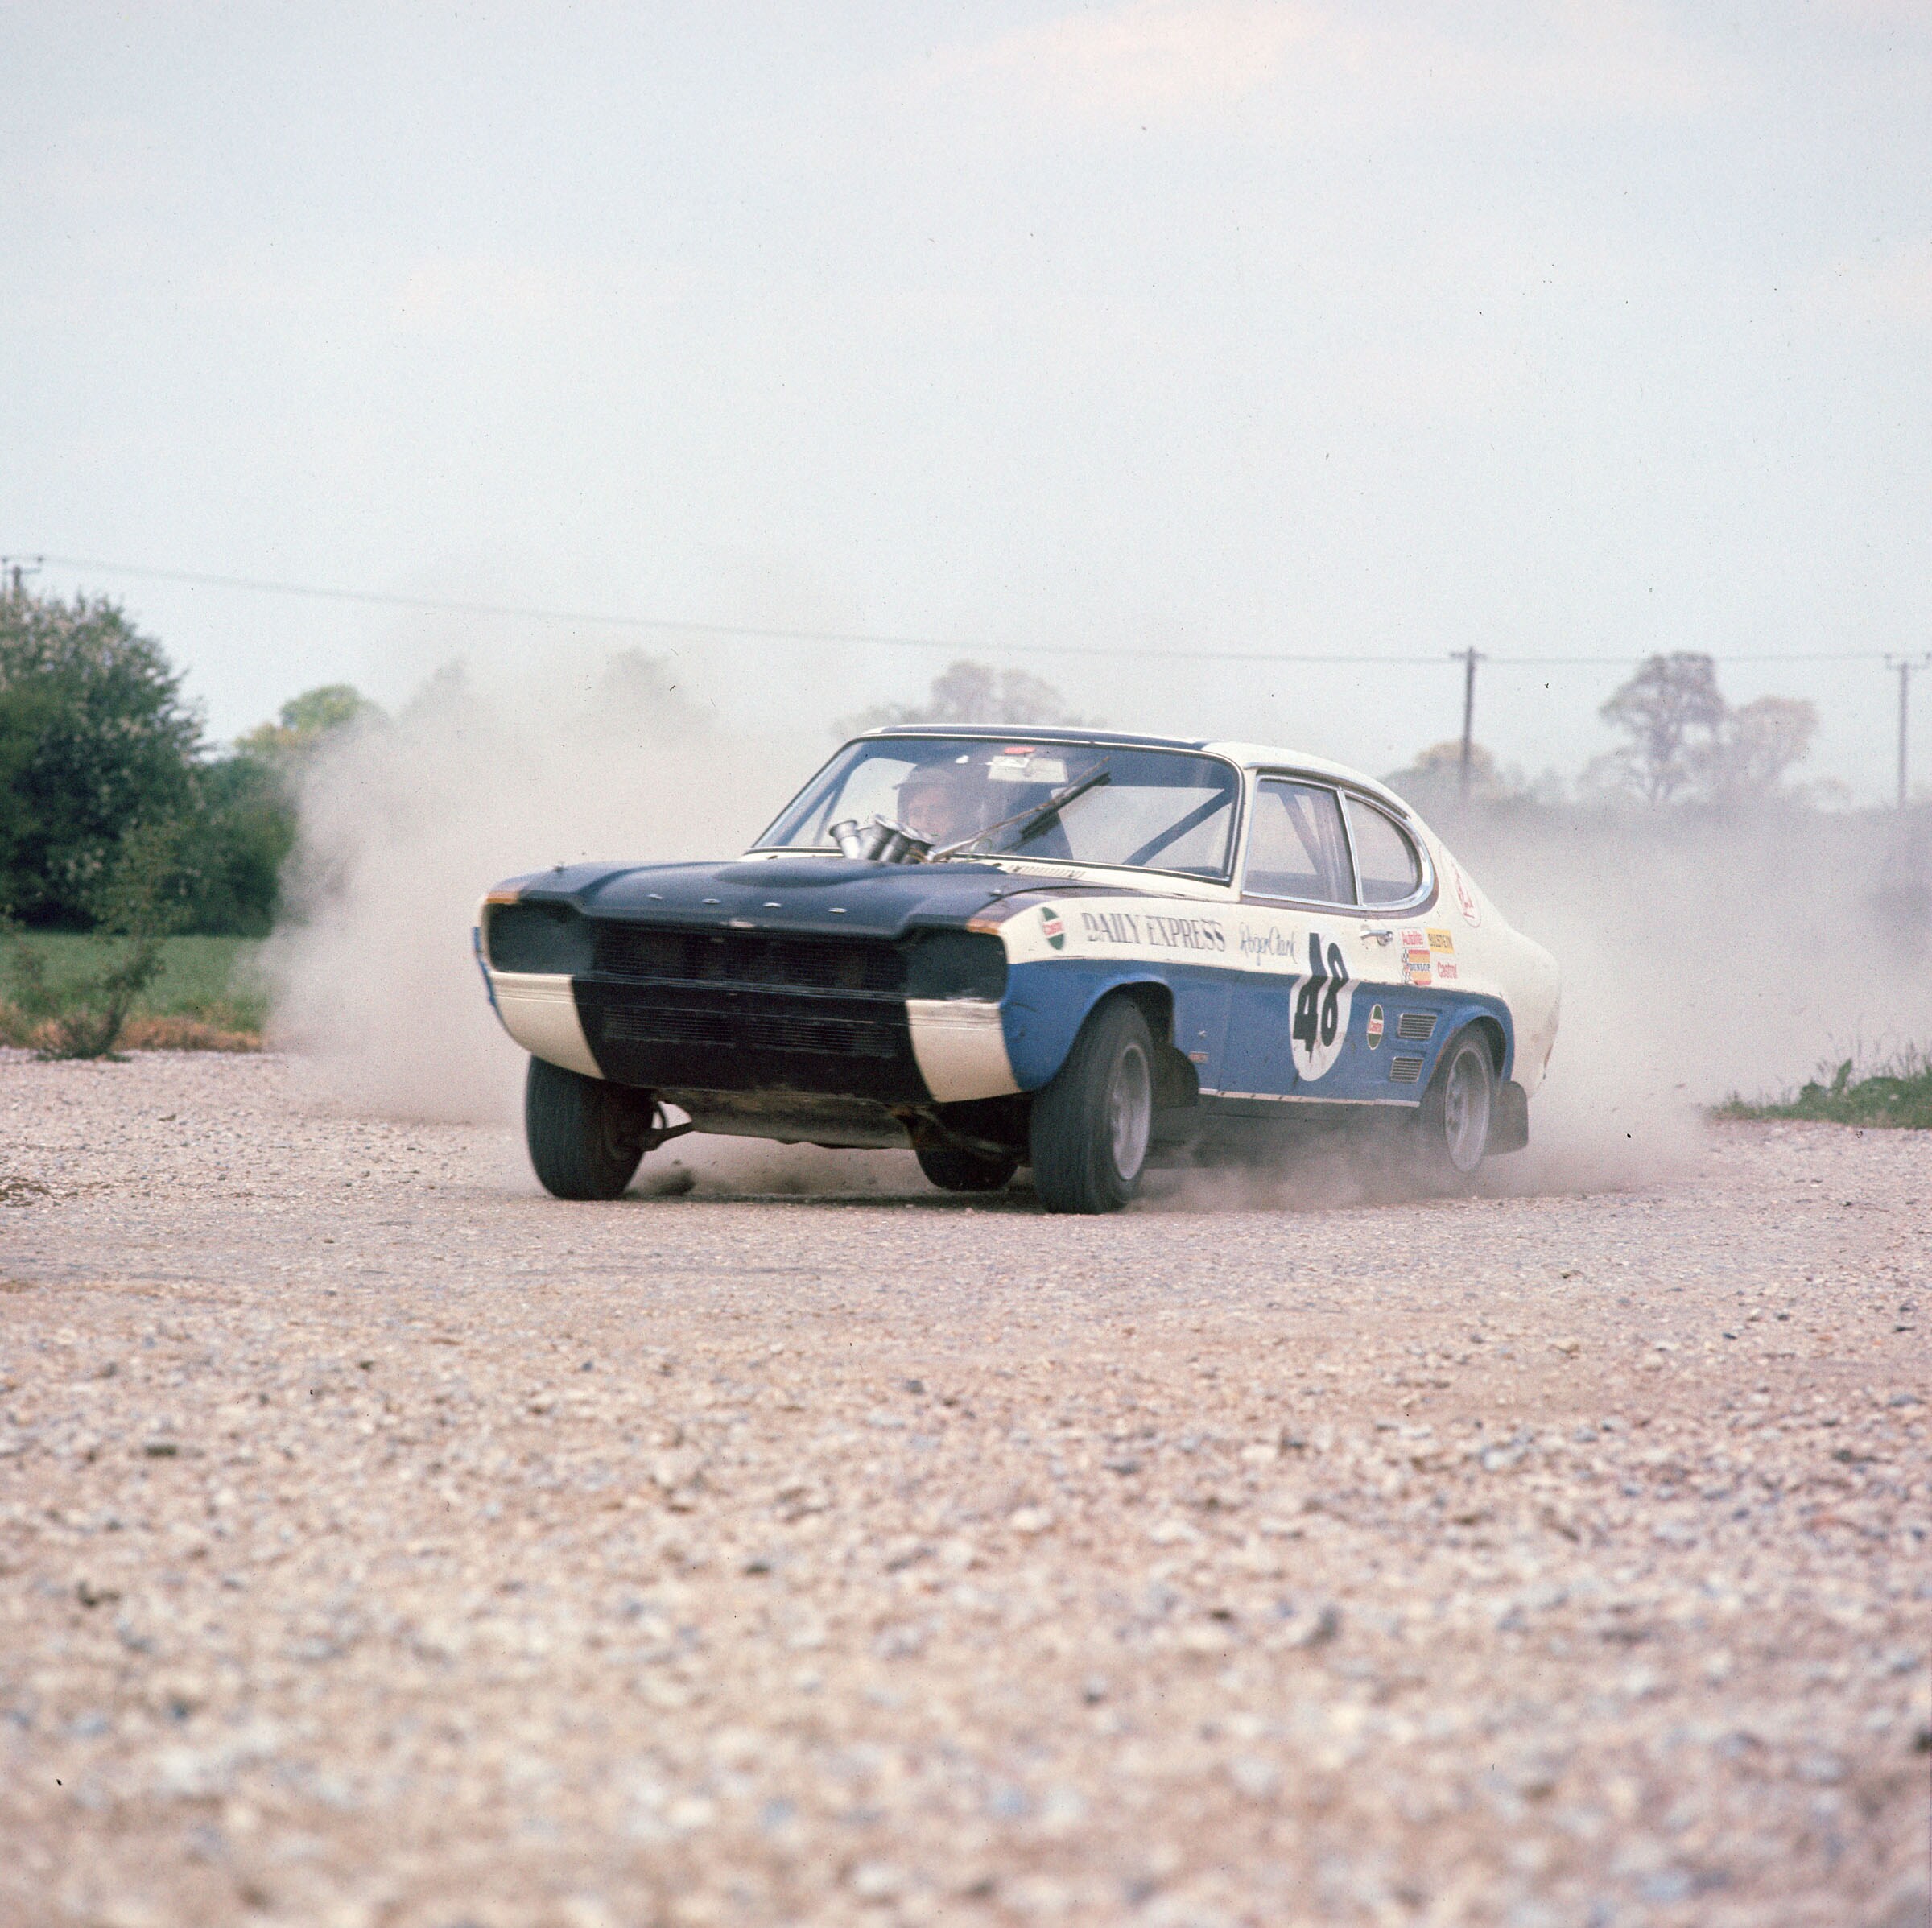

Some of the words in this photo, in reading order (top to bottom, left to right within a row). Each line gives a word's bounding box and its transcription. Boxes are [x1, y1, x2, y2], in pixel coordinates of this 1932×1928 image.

[1081, 911, 1141, 945] DAILY
[1144, 914, 1226, 952] EXPRESS
[1428, 933, 1453, 948] BILSTEIN
[1293, 932, 1350, 1063] 48
